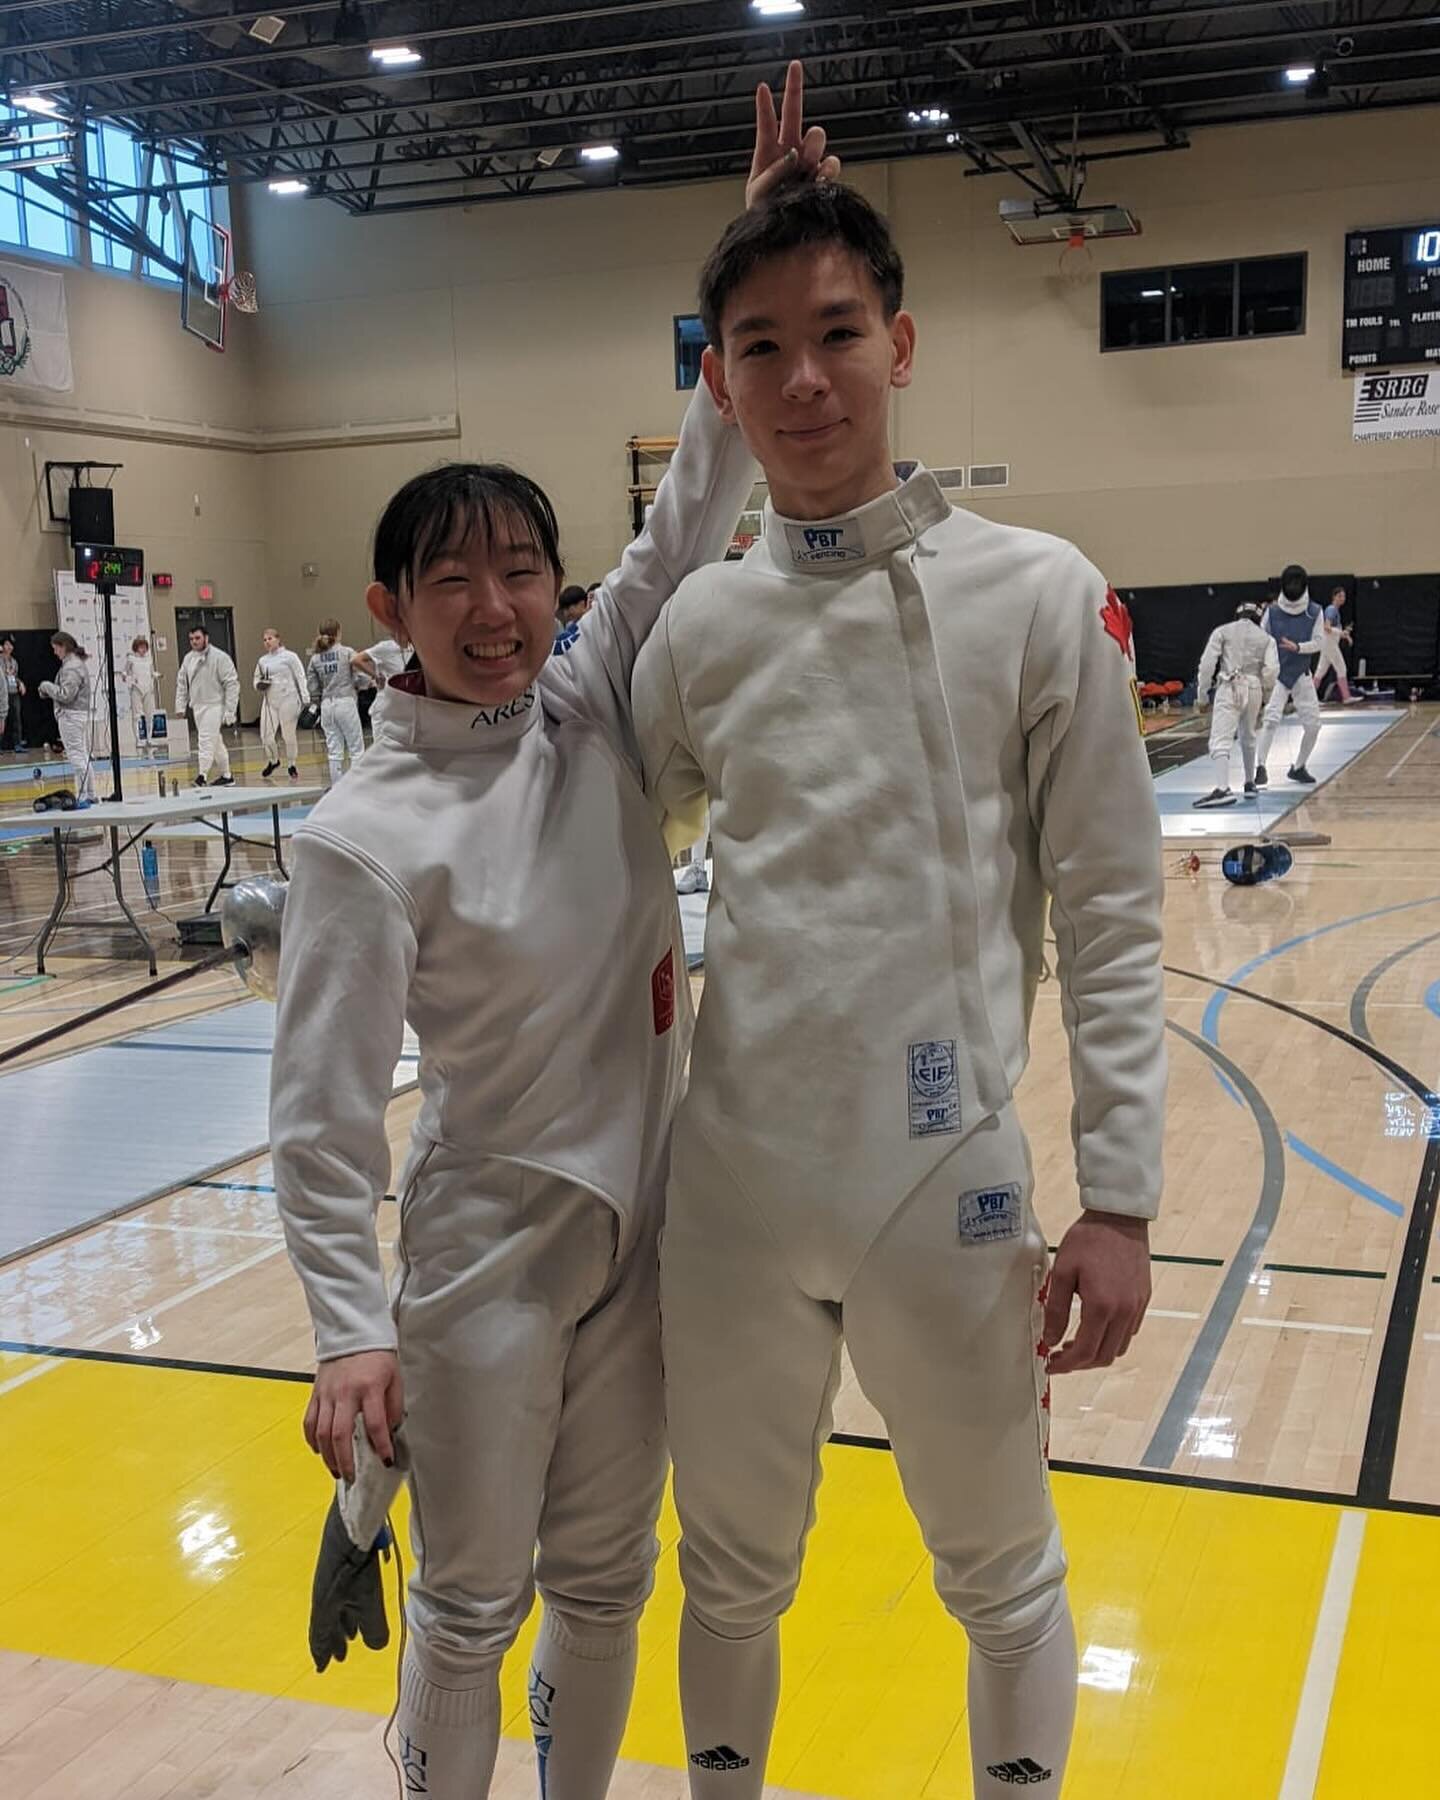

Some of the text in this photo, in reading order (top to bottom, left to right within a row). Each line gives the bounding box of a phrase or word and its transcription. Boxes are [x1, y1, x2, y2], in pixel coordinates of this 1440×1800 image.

[1357, 257, 1391, 273] HOME
[1360, 316, 1384, 328] FOULS
[1348, 353, 1377, 365] POINTS
[1374, 377, 1425, 399] SRBG
[1381, 402, 1415, 419] Sander
[1353, 431, 1392, 442] CHARTERED
[803, 528, 844, 549] PBT
[977, 1191, 1010, 1212] PBT
[690, 1753, 750, 1771] adidas
[986, 1765, 1052, 1785] adidas
